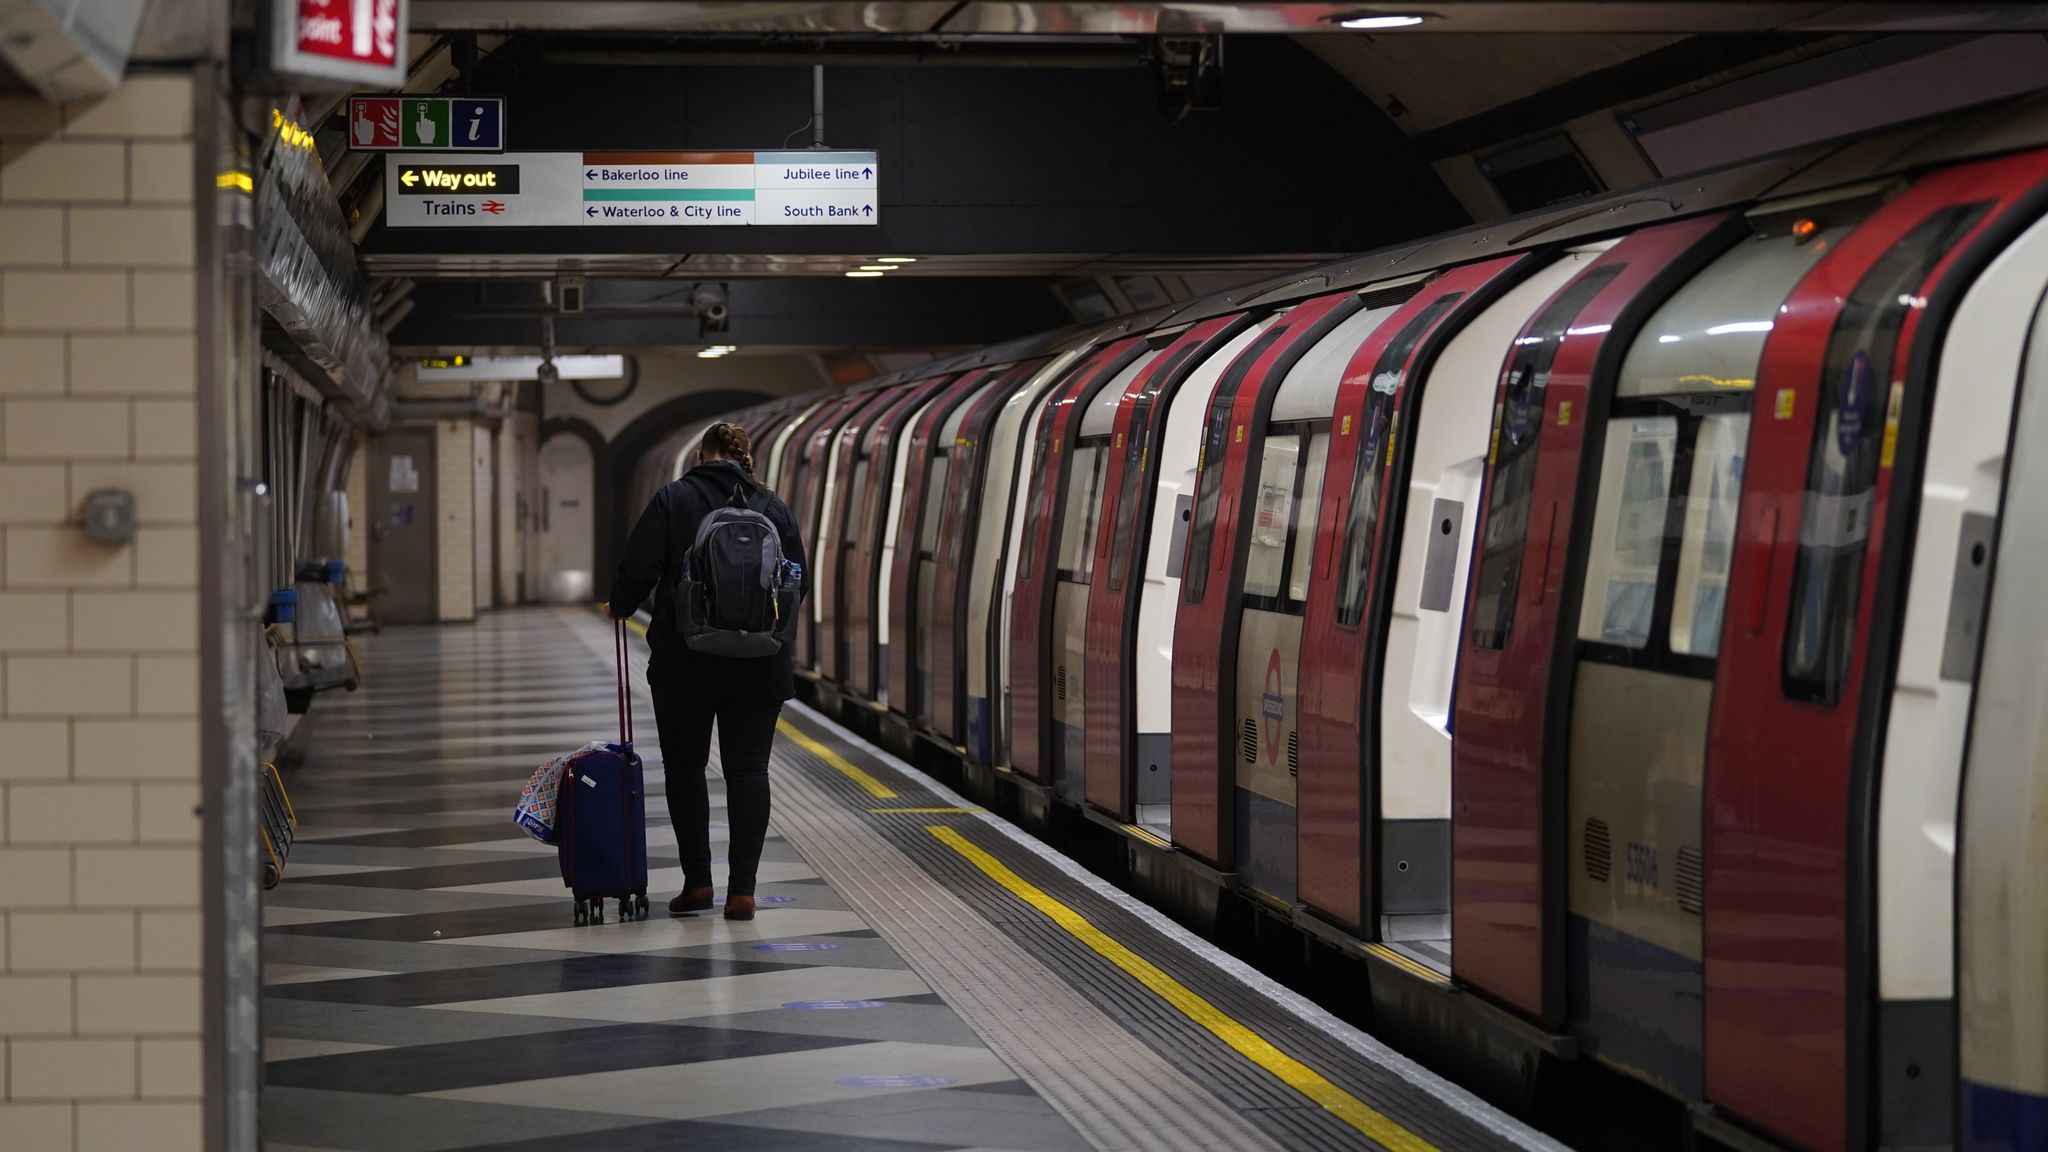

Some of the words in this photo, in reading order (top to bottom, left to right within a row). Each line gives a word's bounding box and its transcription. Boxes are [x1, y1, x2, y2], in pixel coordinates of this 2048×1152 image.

[421, 169, 461, 190] Way
[463, 170, 497, 187] out
[601, 168, 660, 181] Bakerloo
[664, 169, 689, 181] line
[783, 168, 831, 180] Jubilee
[835, 168, 860, 180] line
[422, 200, 476, 216] Trains
[601, 205, 665, 218] Waterloo
[669, 205, 680, 217] &
[684, 205, 713, 220] City
[717, 205, 741, 217] line
[784, 205, 824, 217] South
[828, 204, 860, 217] Bank
